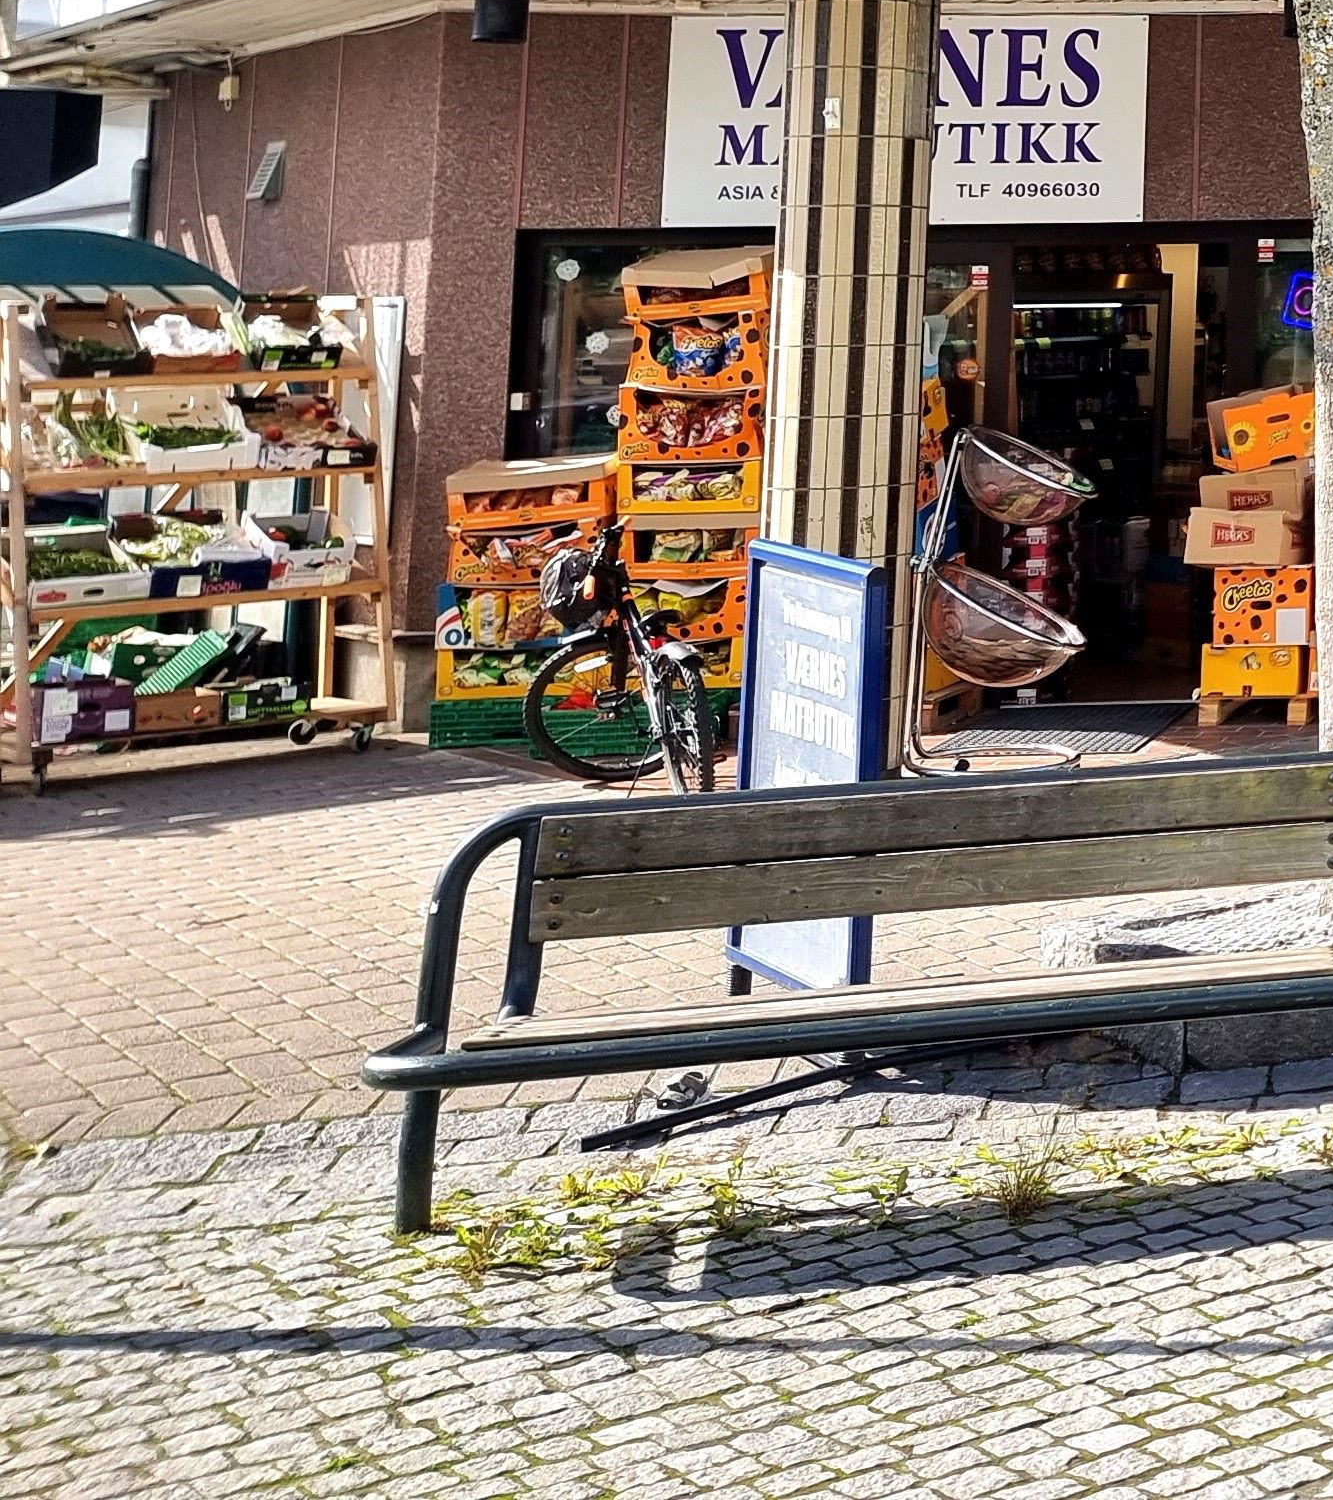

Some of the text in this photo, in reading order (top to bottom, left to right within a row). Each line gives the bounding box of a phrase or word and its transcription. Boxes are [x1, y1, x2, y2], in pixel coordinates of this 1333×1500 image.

[716, 28, 1101, 109] VNES
[714, 122, 1103, 166] MTIKK
[717, 184, 764, 200] ASIA
[956, 183, 991, 198] TLF
[1001, 182, 1101, 198] 40966030
[1222, 580, 1275, 612] Cheetos
[785, 639, 847, 700] VÆRNES
